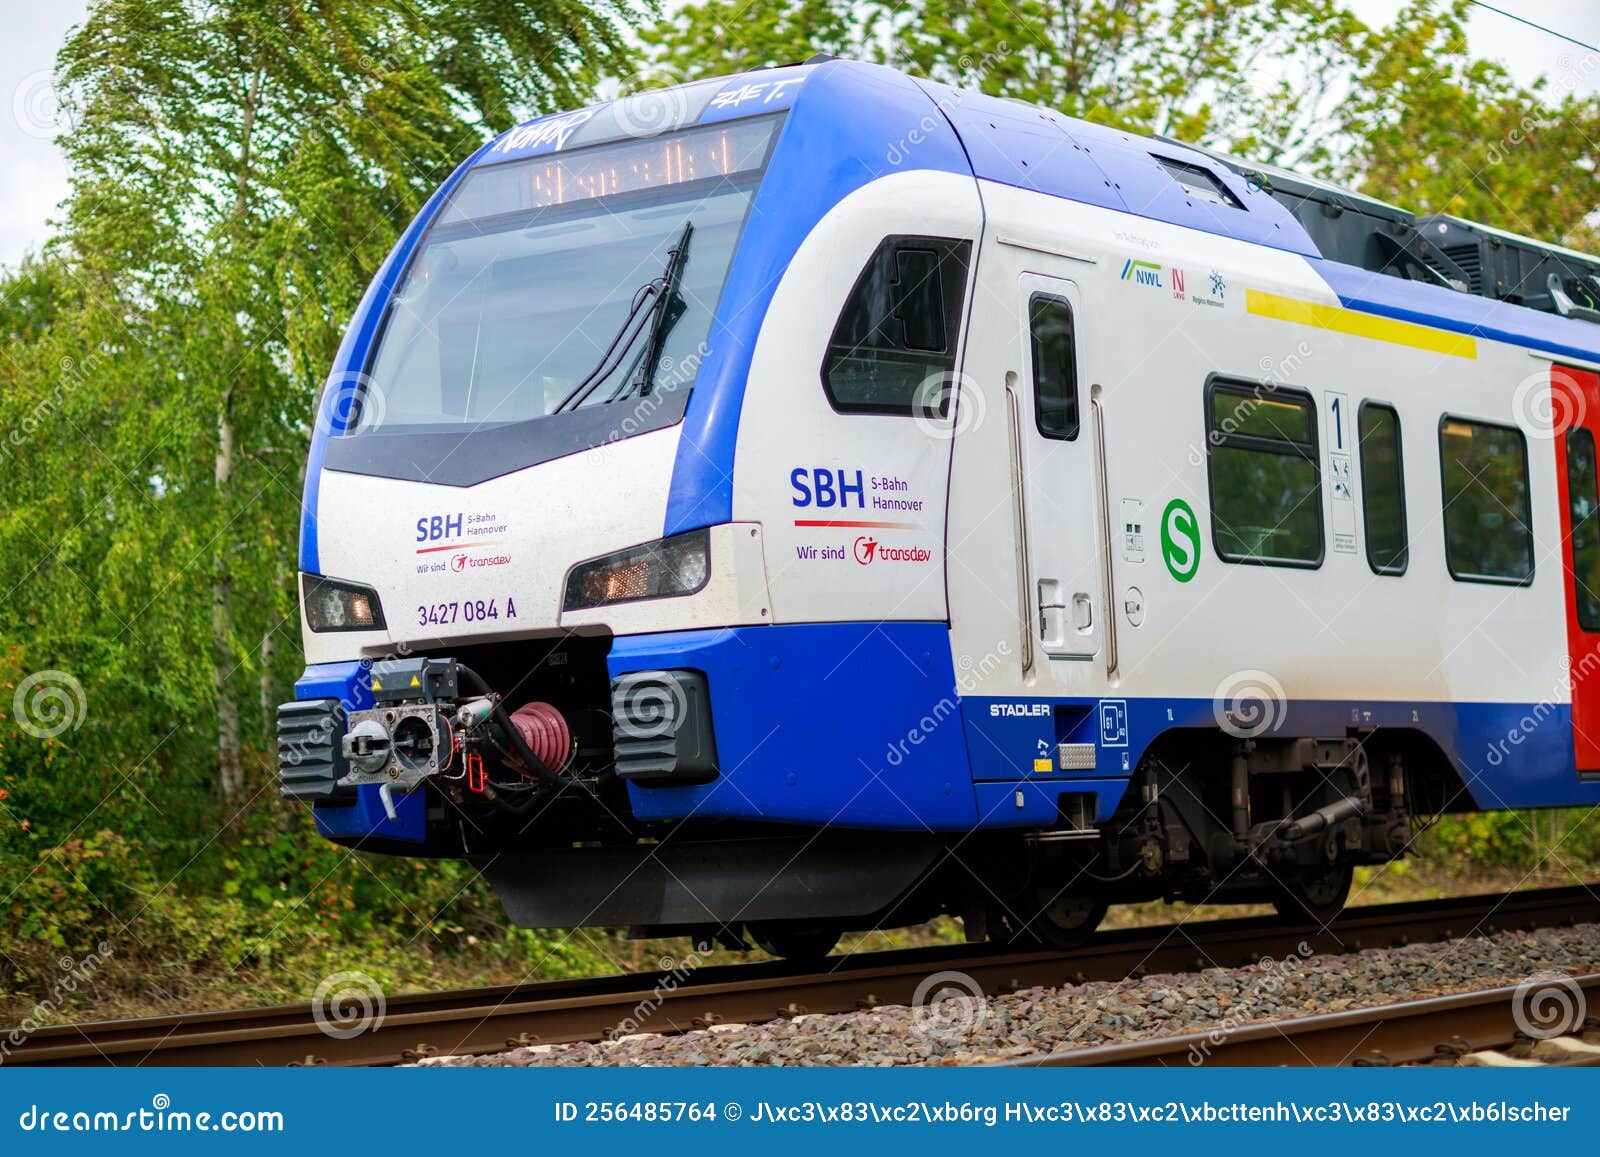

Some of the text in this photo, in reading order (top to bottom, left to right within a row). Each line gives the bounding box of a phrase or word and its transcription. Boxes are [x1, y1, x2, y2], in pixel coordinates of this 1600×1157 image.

[1136, 269, 1162, 288] NWL
[1331, 397, 1342, 449] 1
[790, 467, 865, 508] SBH
[871, 476, 908, 491] S-Bahn
[872, 496, 923, 511] Hannover
[416, 512, 463, 542] SBH
[467, 513, 496, 524] S-Bahn
[467, 524, 507, 536] Hannover
[1167, 507, 1195, 575] S
[796, 545, 931, 562] Wir sind transdev
[416, 555, 511, 574] Wir sind transdev
[418, 597, 517, 626] 3427 084 A
[990, 704, 1051, 717] STADLER
